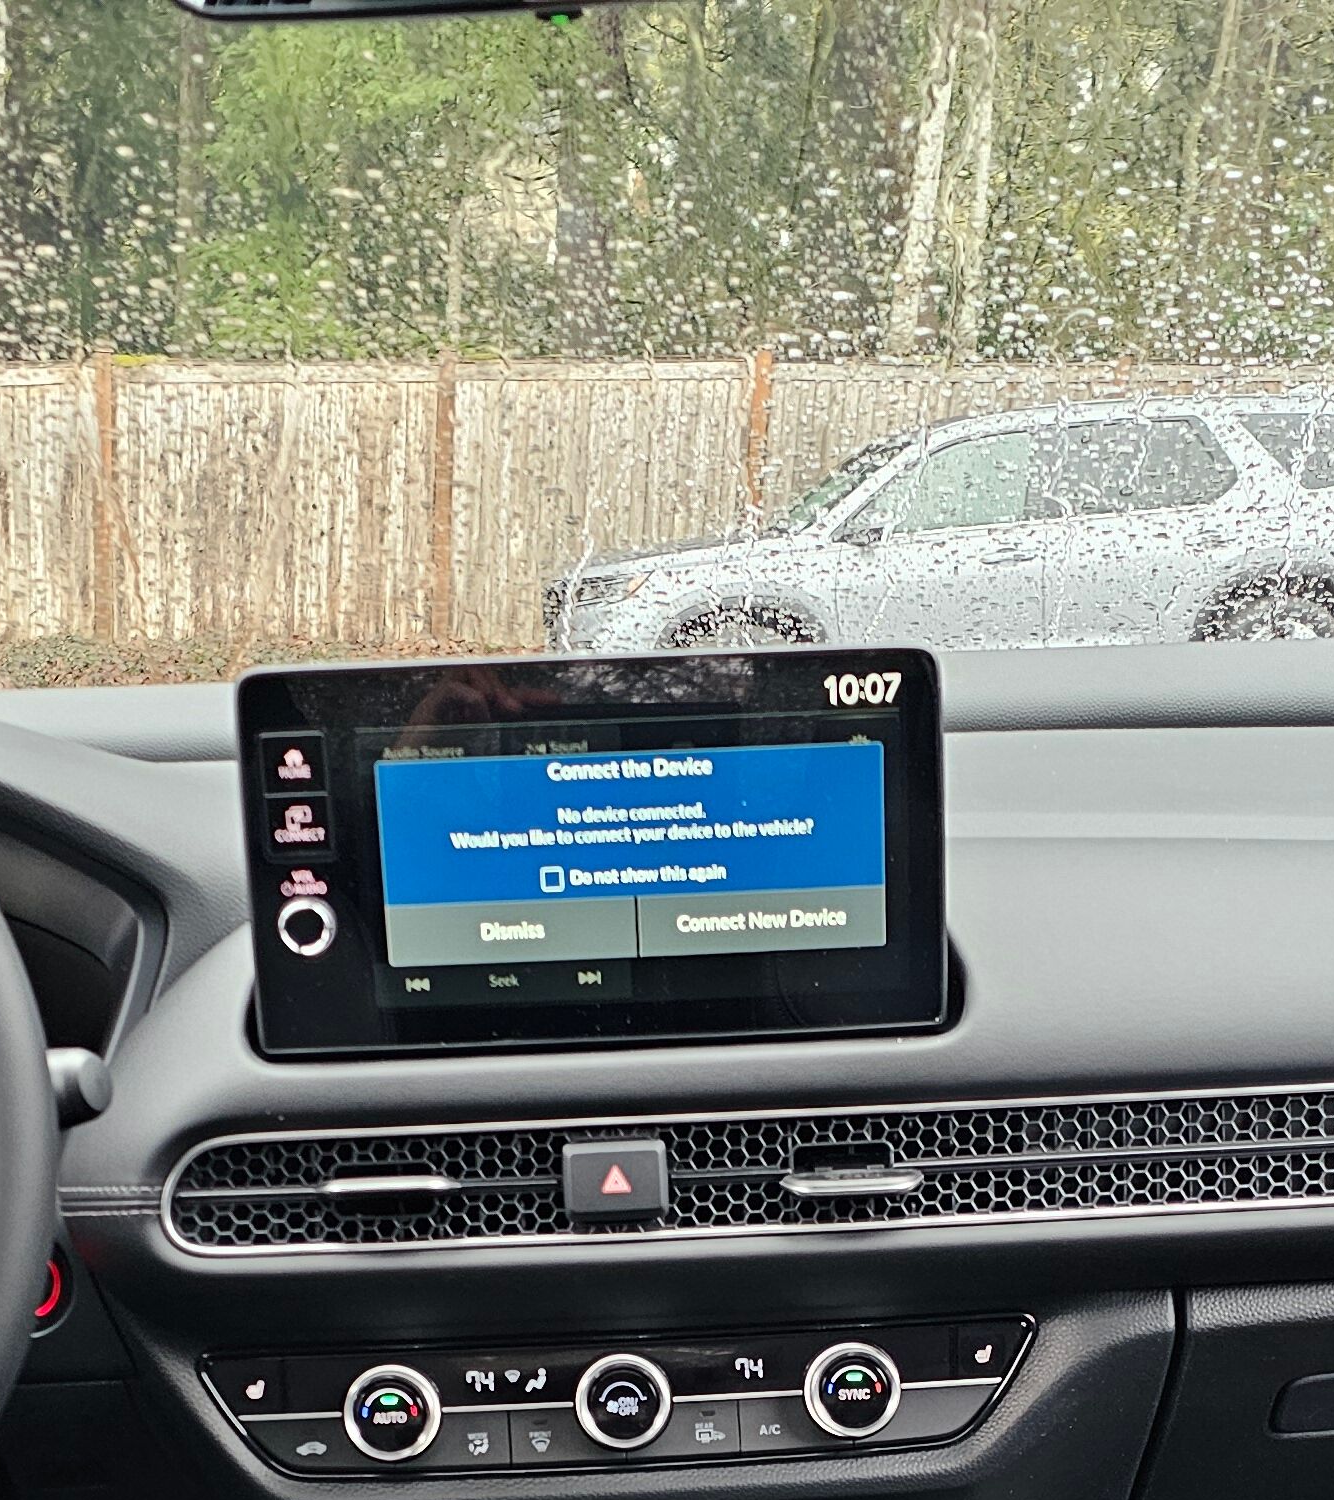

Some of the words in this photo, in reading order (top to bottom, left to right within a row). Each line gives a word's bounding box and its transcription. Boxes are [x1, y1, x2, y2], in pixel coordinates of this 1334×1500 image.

[824, 672, 901, 706] 10:07
[547, 761, 620, 781] Connect
[621, 759, 651, 778] the
[653, 756, 712, 777] Device
[557, 808, 581, 824] No
[582, 806, 628, 823] device
[629, 802, 706, 821] connected.
[450, 831, 499, 849] Would
[500, 833, 528, 849] you
[529, 829, 555, 846] like
[556, 830, 573, 845] to
[574, 827, 632, 844] connect
[632, 827, 666, 844] your
[667, 823, 713, 841] device
[714, 824, 731, 839] to
[732, 821, 757, 838] the
[758, 818, 814, 836] vehicle?
[570, 869, 593, 886] Do
[594, 869, 619, 884] not
[620, 867, 658, 883] show
[660, 865, 687, 882] this
[688, 864, 726, 882] again
[480, 921, 545, 941] Dismiss
[677, 913, 745, 933] Connect
[748, 911, 787, 929] New
[790, 908, 846, 928] Device
[489, 974, 519, 987] Seek
[735, 1358, 763, 1378] 74
[466, 1371, 494, 1392] 74
[838, 1389, 870, 1400] SYNC
[373, 1412, 407, 1424] AUTO
[760, 1424, 780, 1435] A/C
